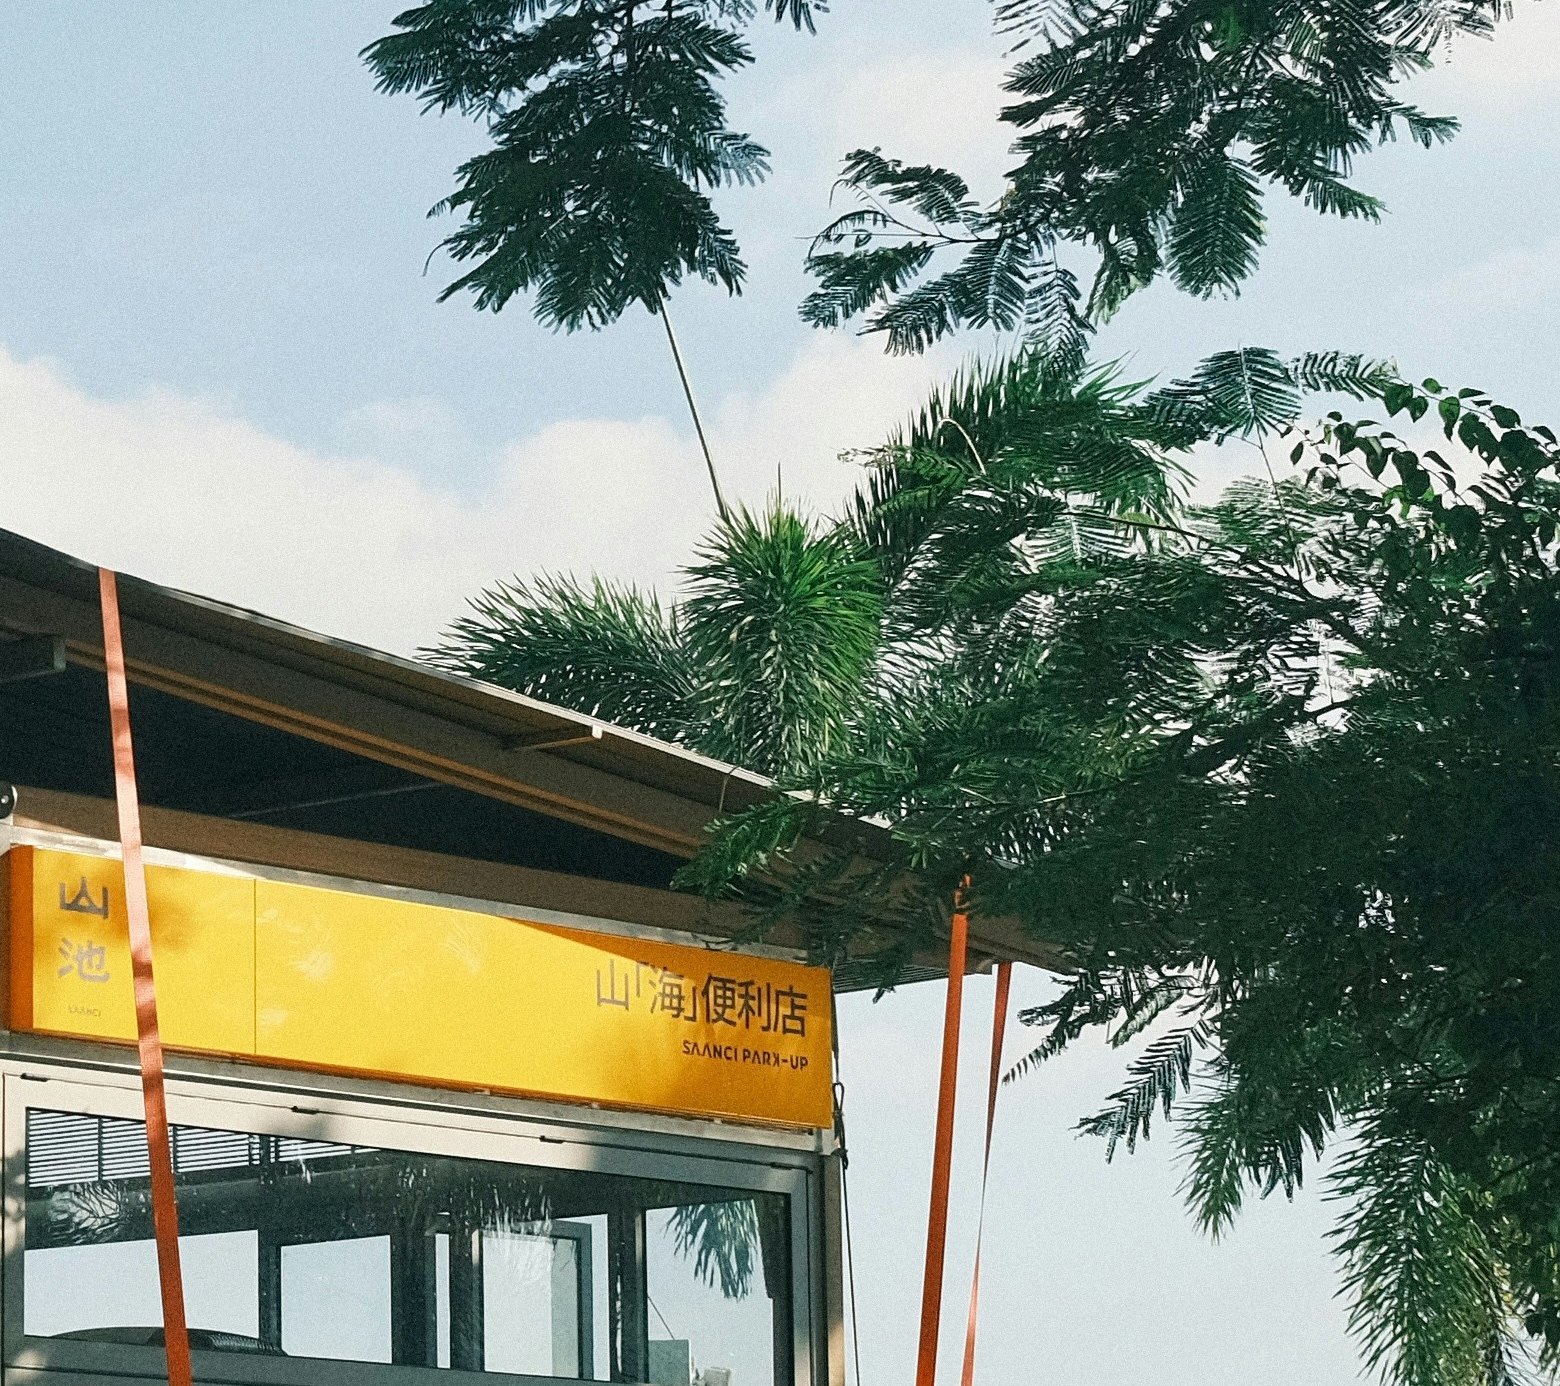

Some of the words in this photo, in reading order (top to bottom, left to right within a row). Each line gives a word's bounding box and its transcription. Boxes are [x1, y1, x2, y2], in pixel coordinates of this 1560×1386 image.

[58, 875, 110, 984] 山池
[596, 958, 808, 1038] 山「海」便利店
[682, 1040, 738, 1062] SAANCI
[742, 1050, 809, 1071] PARK-UP
